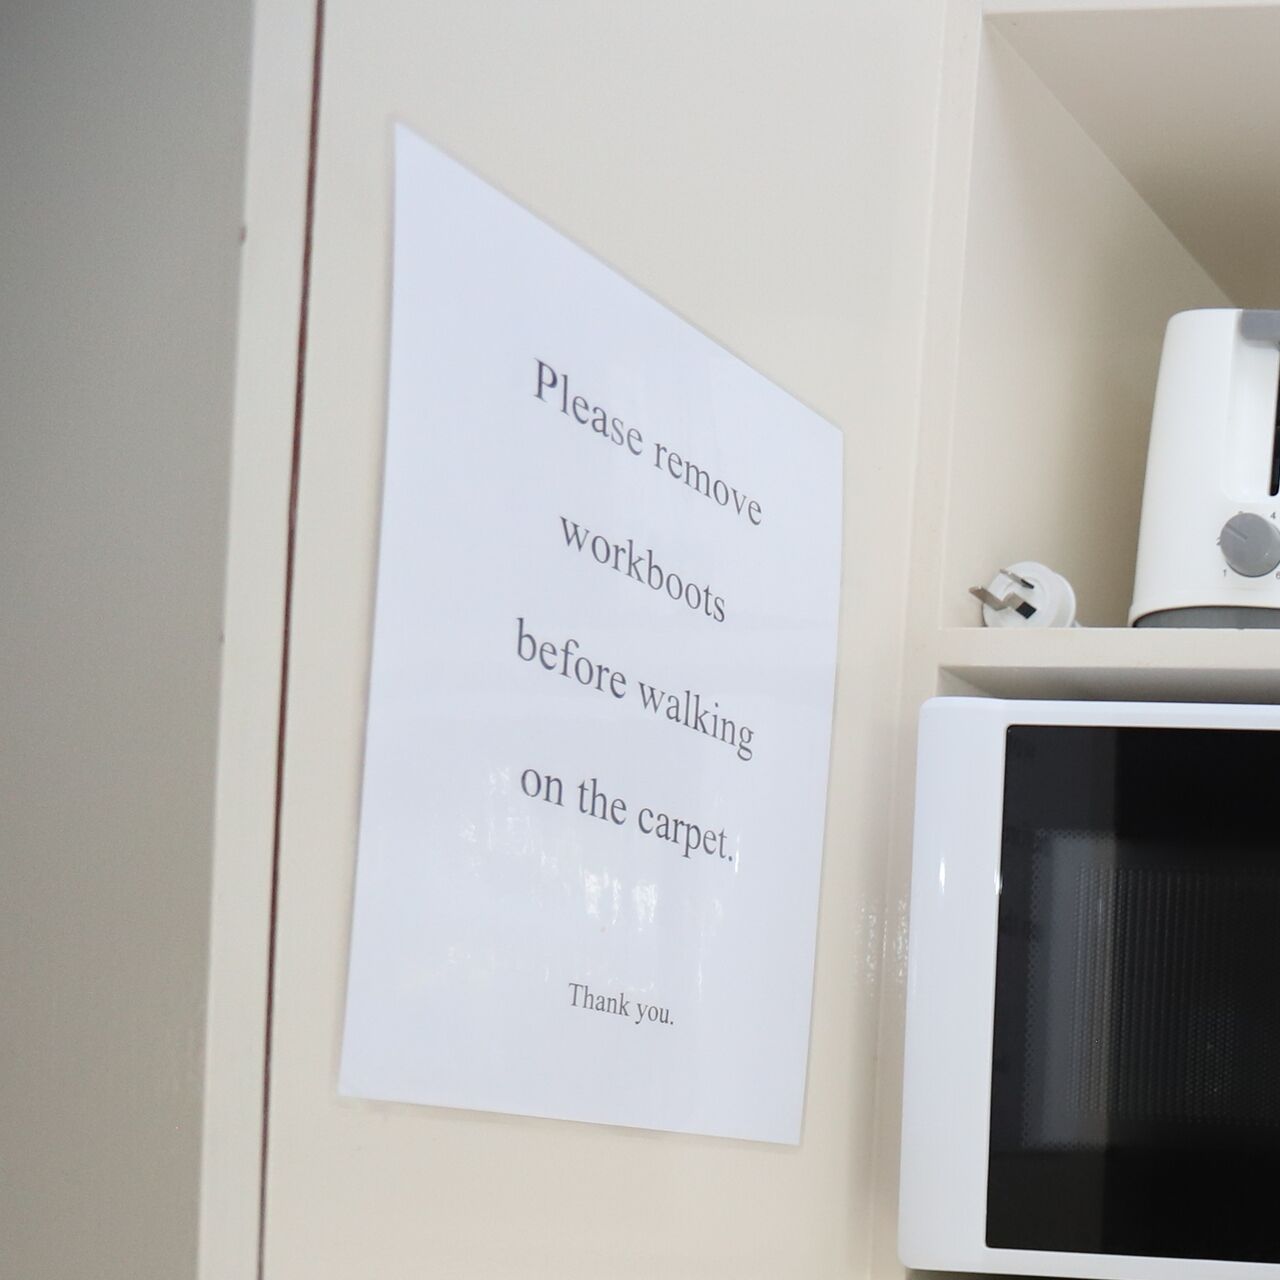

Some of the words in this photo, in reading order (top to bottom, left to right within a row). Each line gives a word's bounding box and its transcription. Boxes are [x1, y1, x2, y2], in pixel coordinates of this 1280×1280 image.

[533, 357, 645, 457] Please
[653, 443, 764, 527] remove
[1269, 511, 1277, 520] 4
[559, 515, 728, 625] workboots
[516, 618, 628, 701] before
[638, 680, 756, 763] walking
[520, 768, 565, 806] on
[577, 778, 628, 826] the
[638, 806, 735, 862] carpet.
[569, 983, 630, 1018] Thank
[635, 998, 675, 1026] you.
